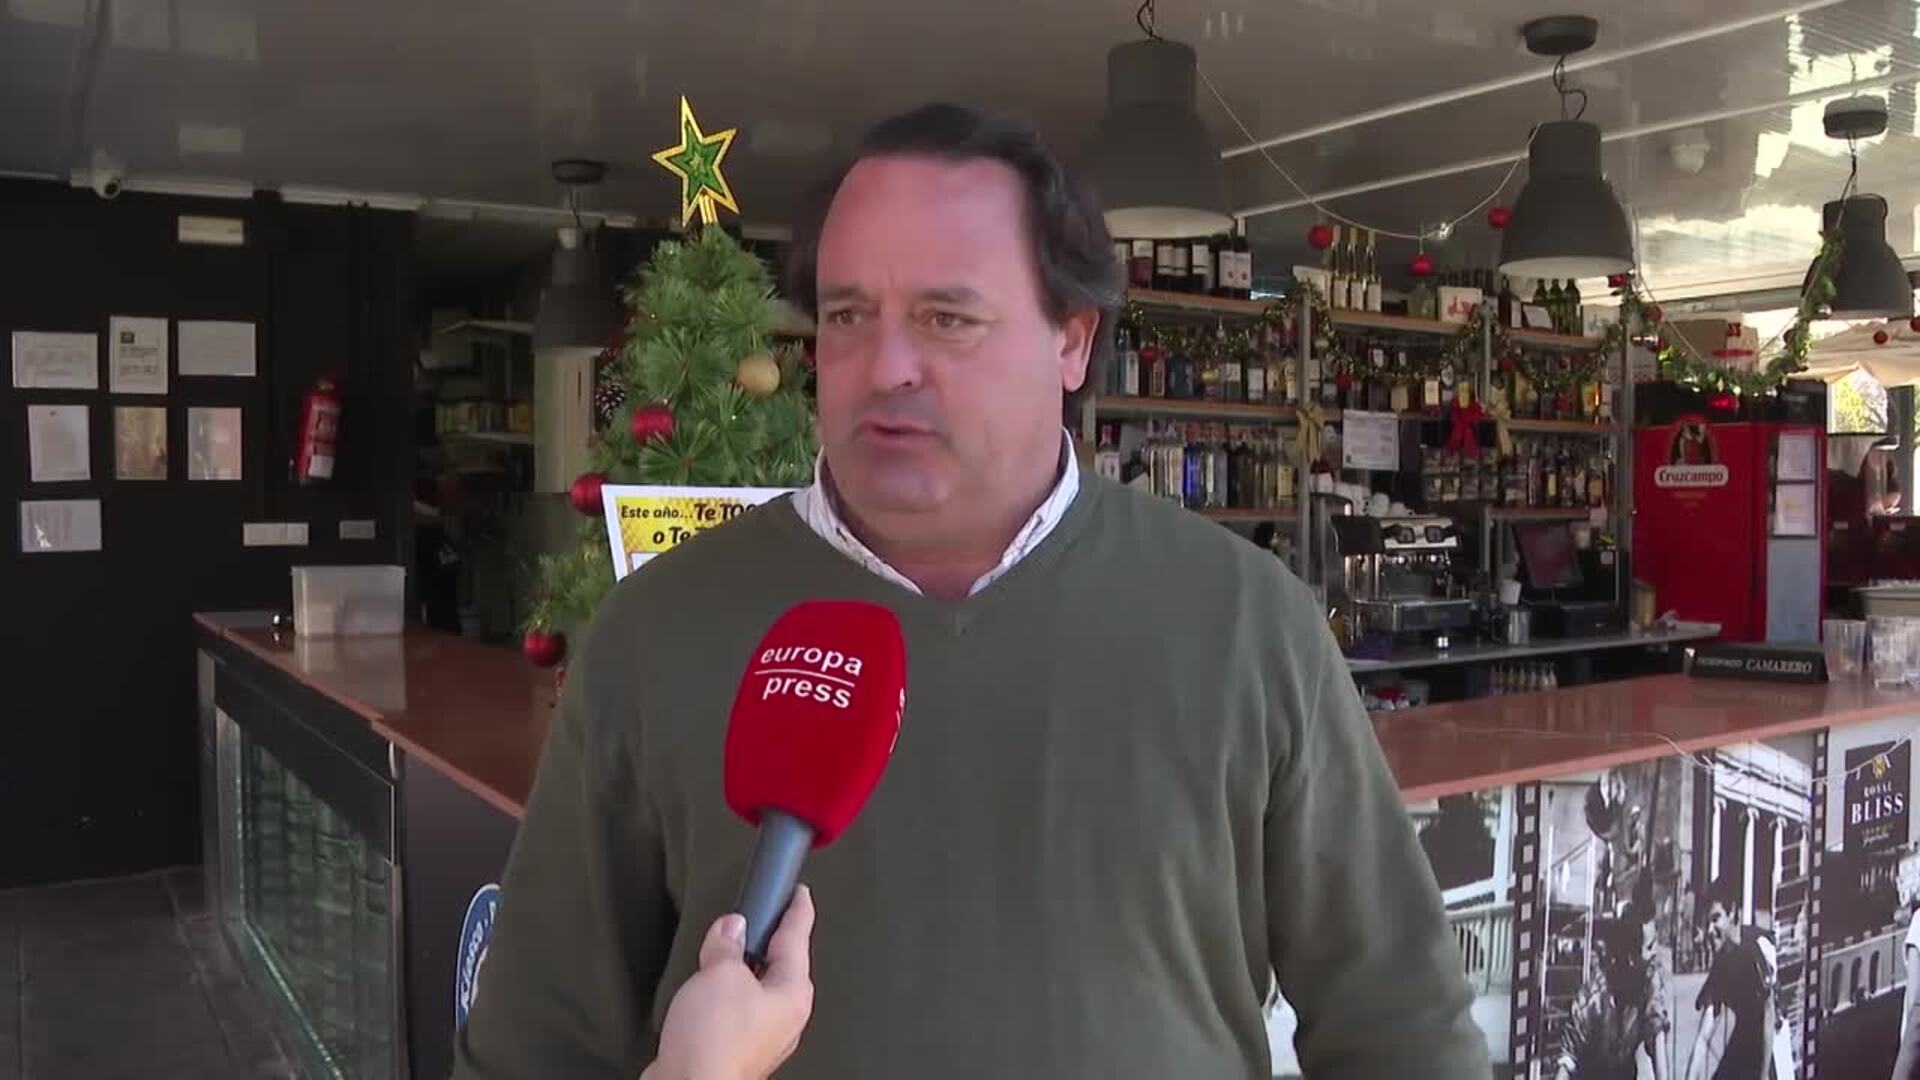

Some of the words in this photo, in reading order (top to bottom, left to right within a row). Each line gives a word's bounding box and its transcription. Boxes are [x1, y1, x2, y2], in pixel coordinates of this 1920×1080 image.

[1659, 469, 1724, 484] Cruzcampo
[621, 505, 650, 519] Este
[694, 503, 717, 521] Te
[652, 530, 665, 544] o
[760, 646, 863, 676] europa
[1745, 658, 1813, 674] CAMARERO
[762, 676, 852, 708] press
[1863, 781, 1893, 798] ROYAL
[1851, 793, 1904, 825] BLISS
